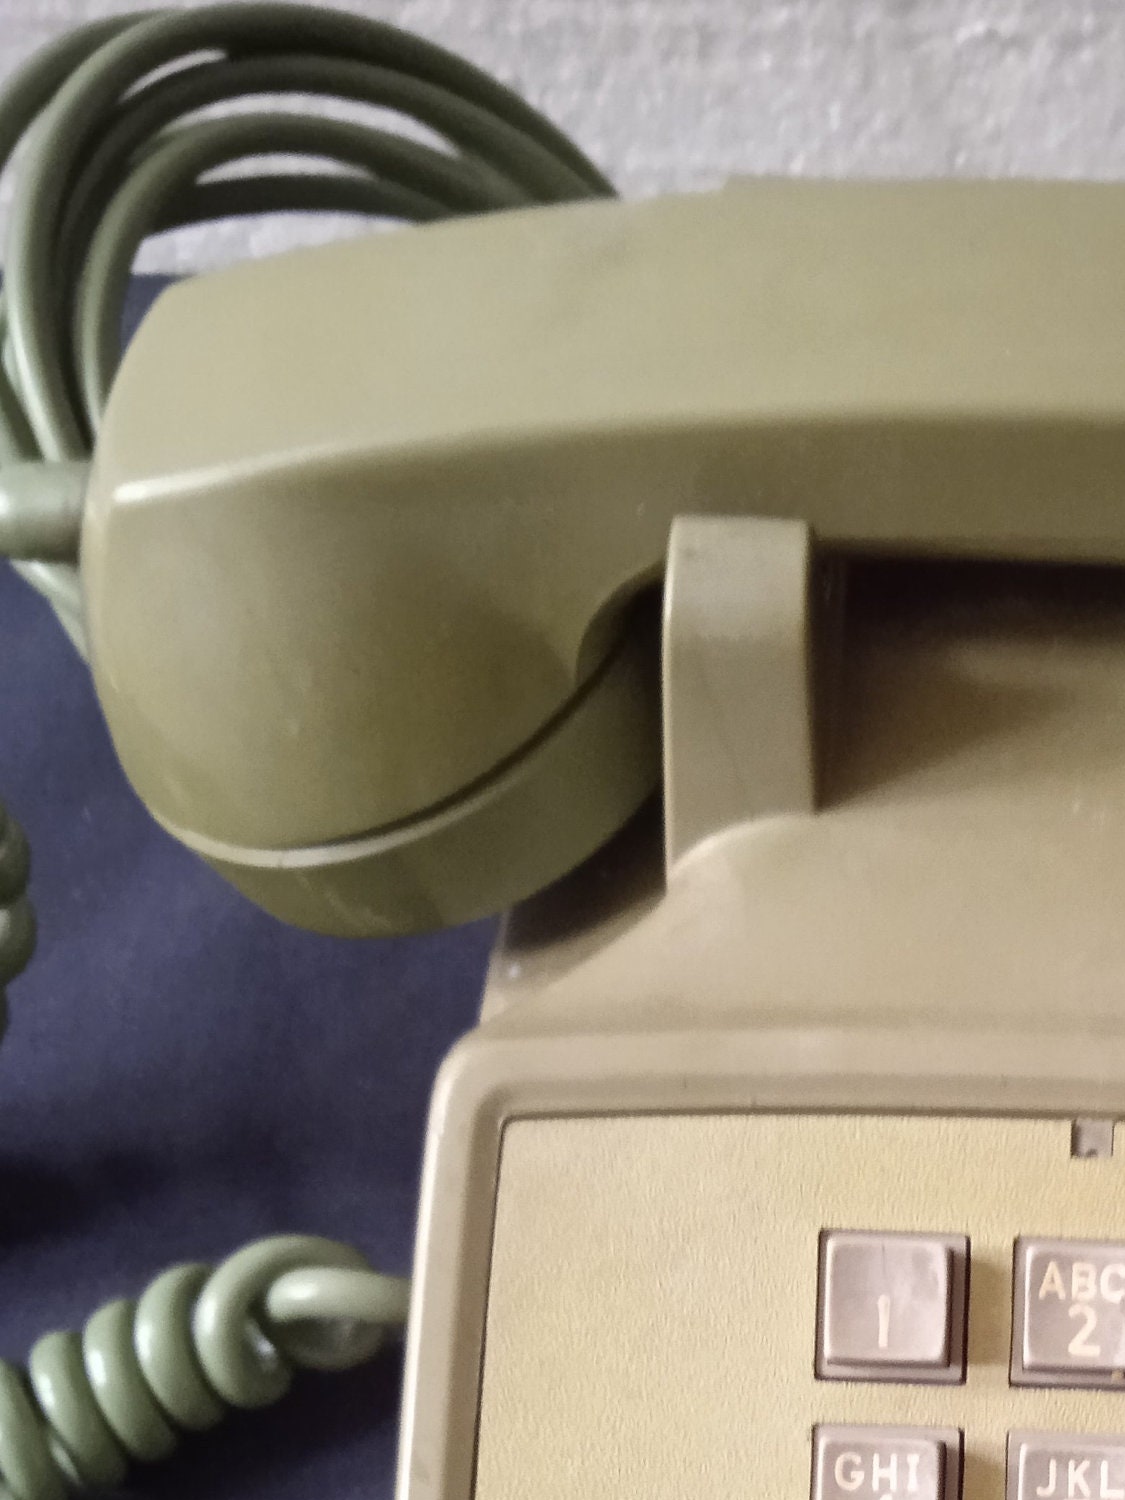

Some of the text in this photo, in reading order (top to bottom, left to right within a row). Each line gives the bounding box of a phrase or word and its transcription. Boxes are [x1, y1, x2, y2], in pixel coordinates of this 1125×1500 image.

[1067, 1304, 1101, 1357] 2
[834, 1452, 919, 1493] GHI
[1036, 1458, 1125, 1499] JKL
